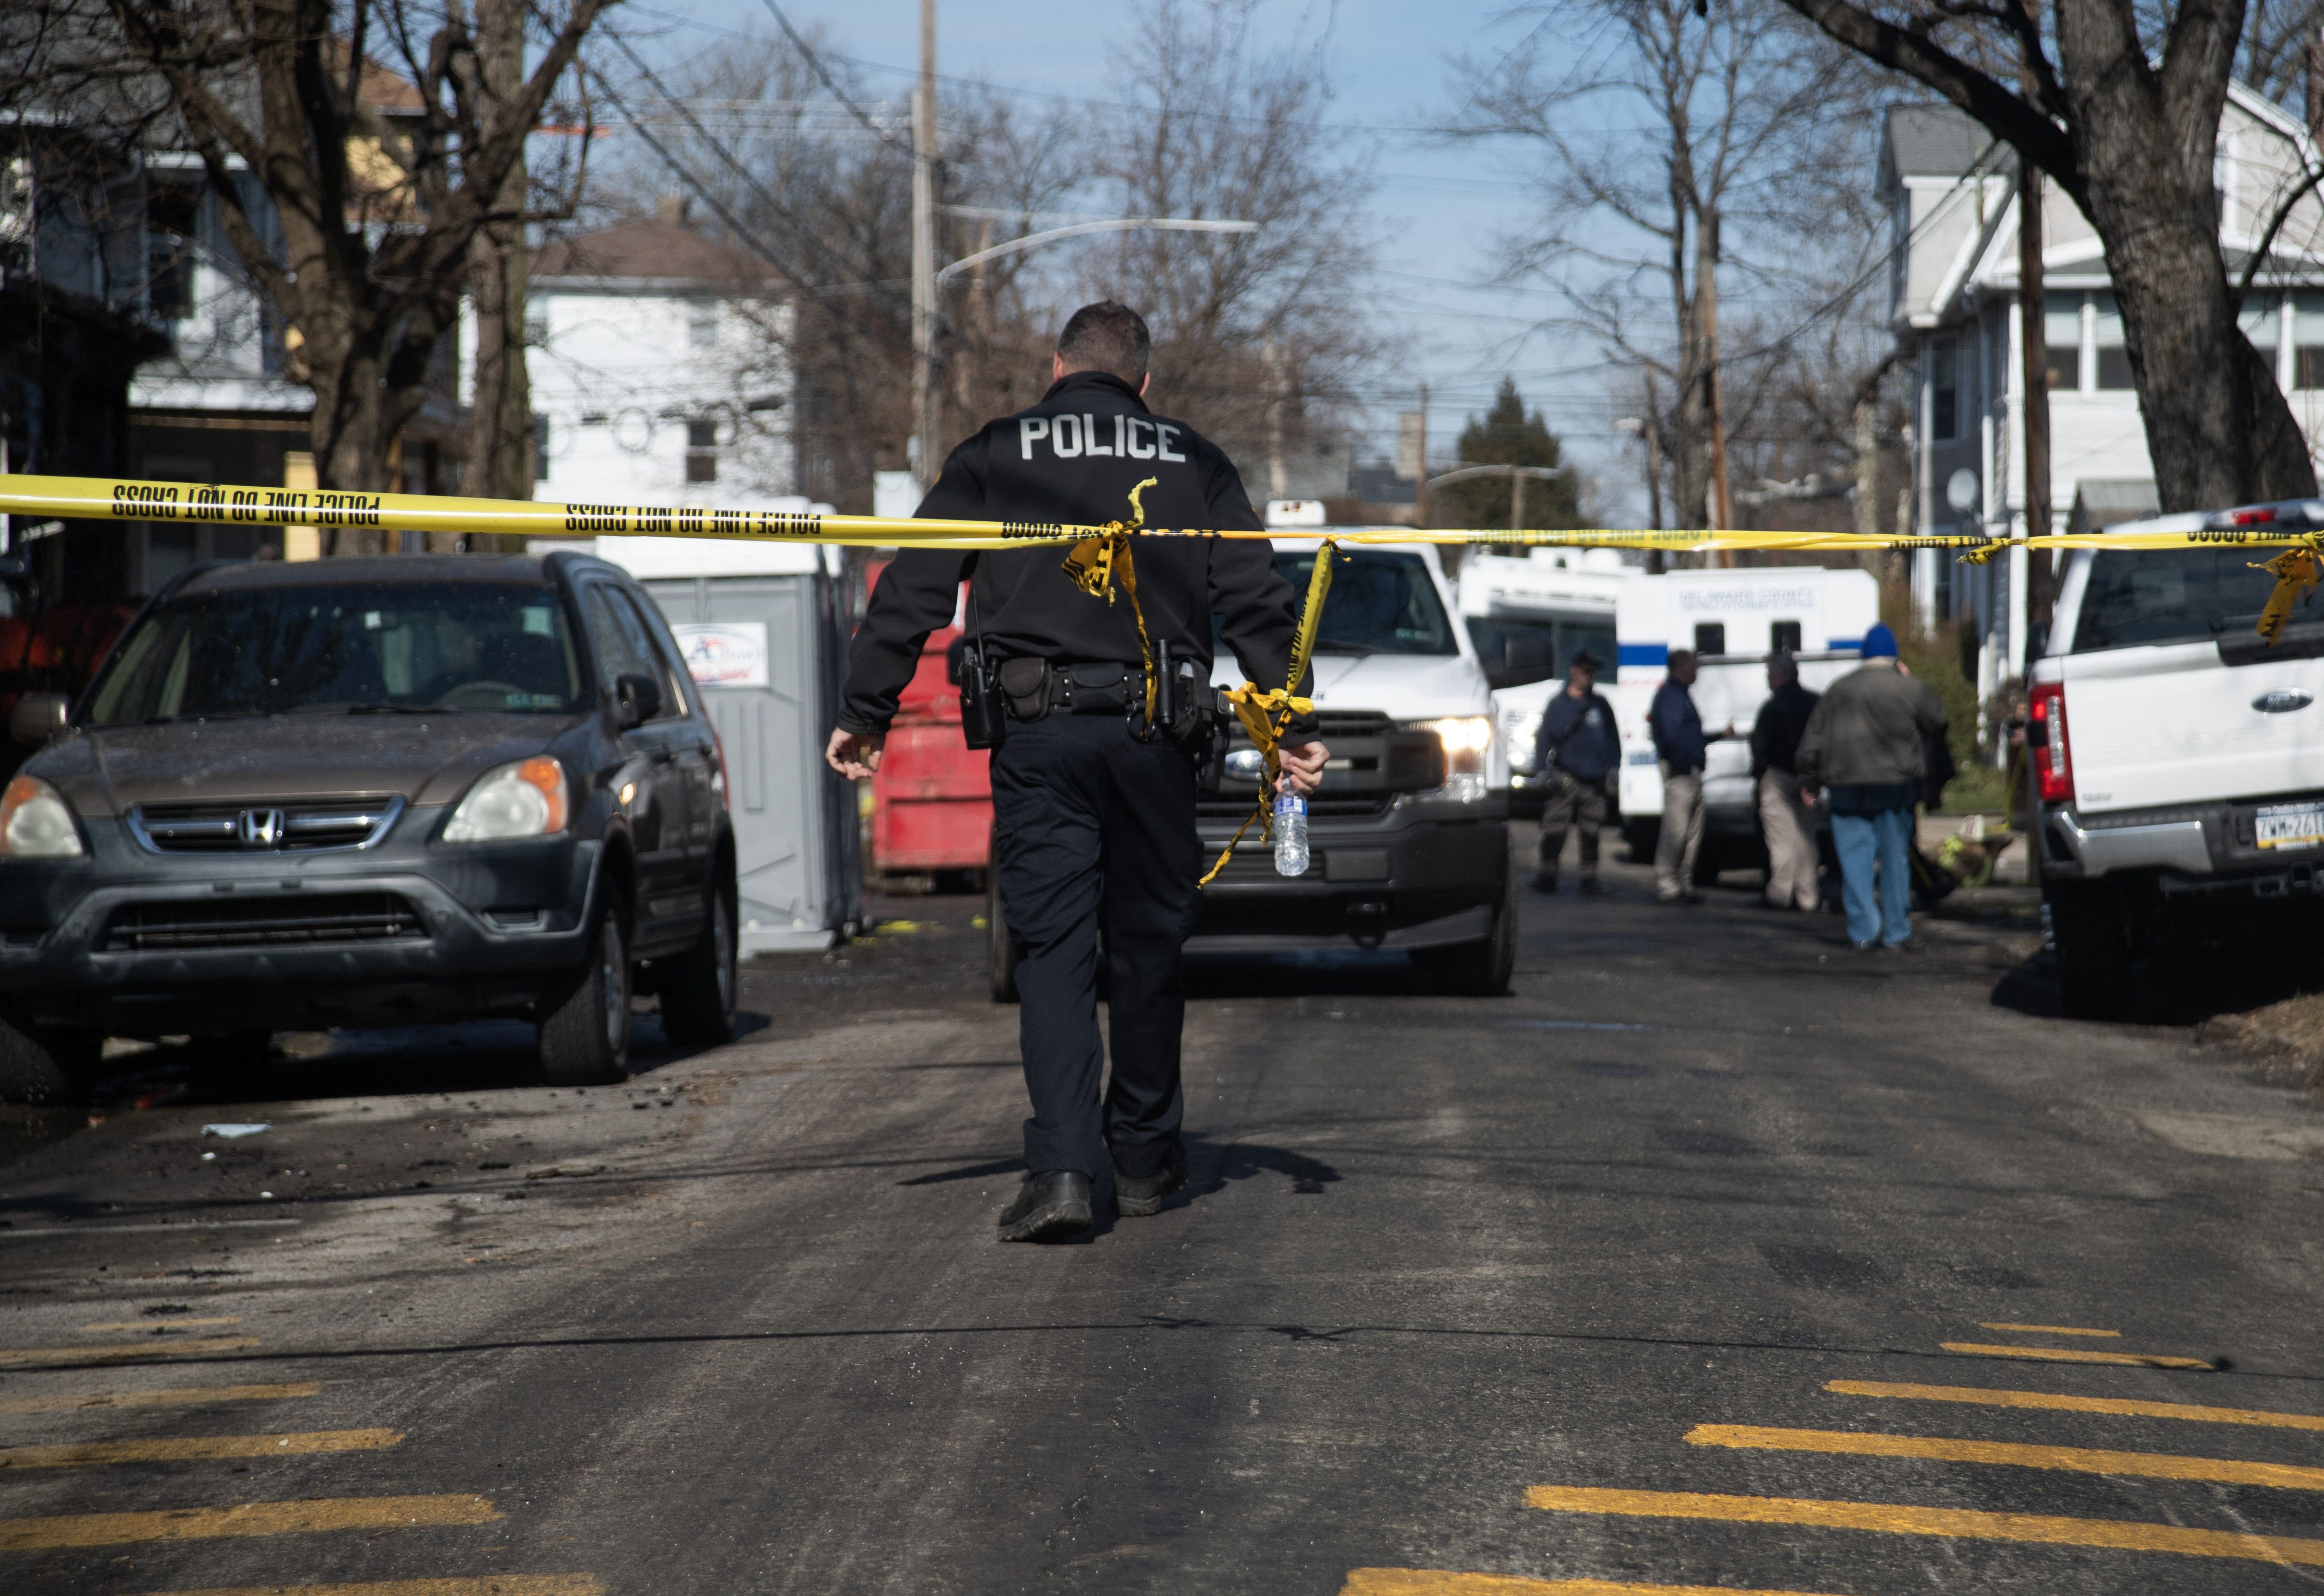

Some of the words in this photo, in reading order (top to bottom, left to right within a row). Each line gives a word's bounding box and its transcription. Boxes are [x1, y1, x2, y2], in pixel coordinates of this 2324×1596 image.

[1019, 412, 1186, 463] POLICE
[112, 484, 179, 518] CROSS
[185, 487, 226, 520] NOT
[233, 490, 258, 521] DO
[265, 492, 308, 523] LINE
[314, 493, 381, 525] POLICE
[565, 504, 627, 531] CROSS
[634, 506, 672, 532] NOT
[679, 508, 704, 533] DO
[709, 510, 751, 533] LINE
[757, 512, 821, 534] POLICE
